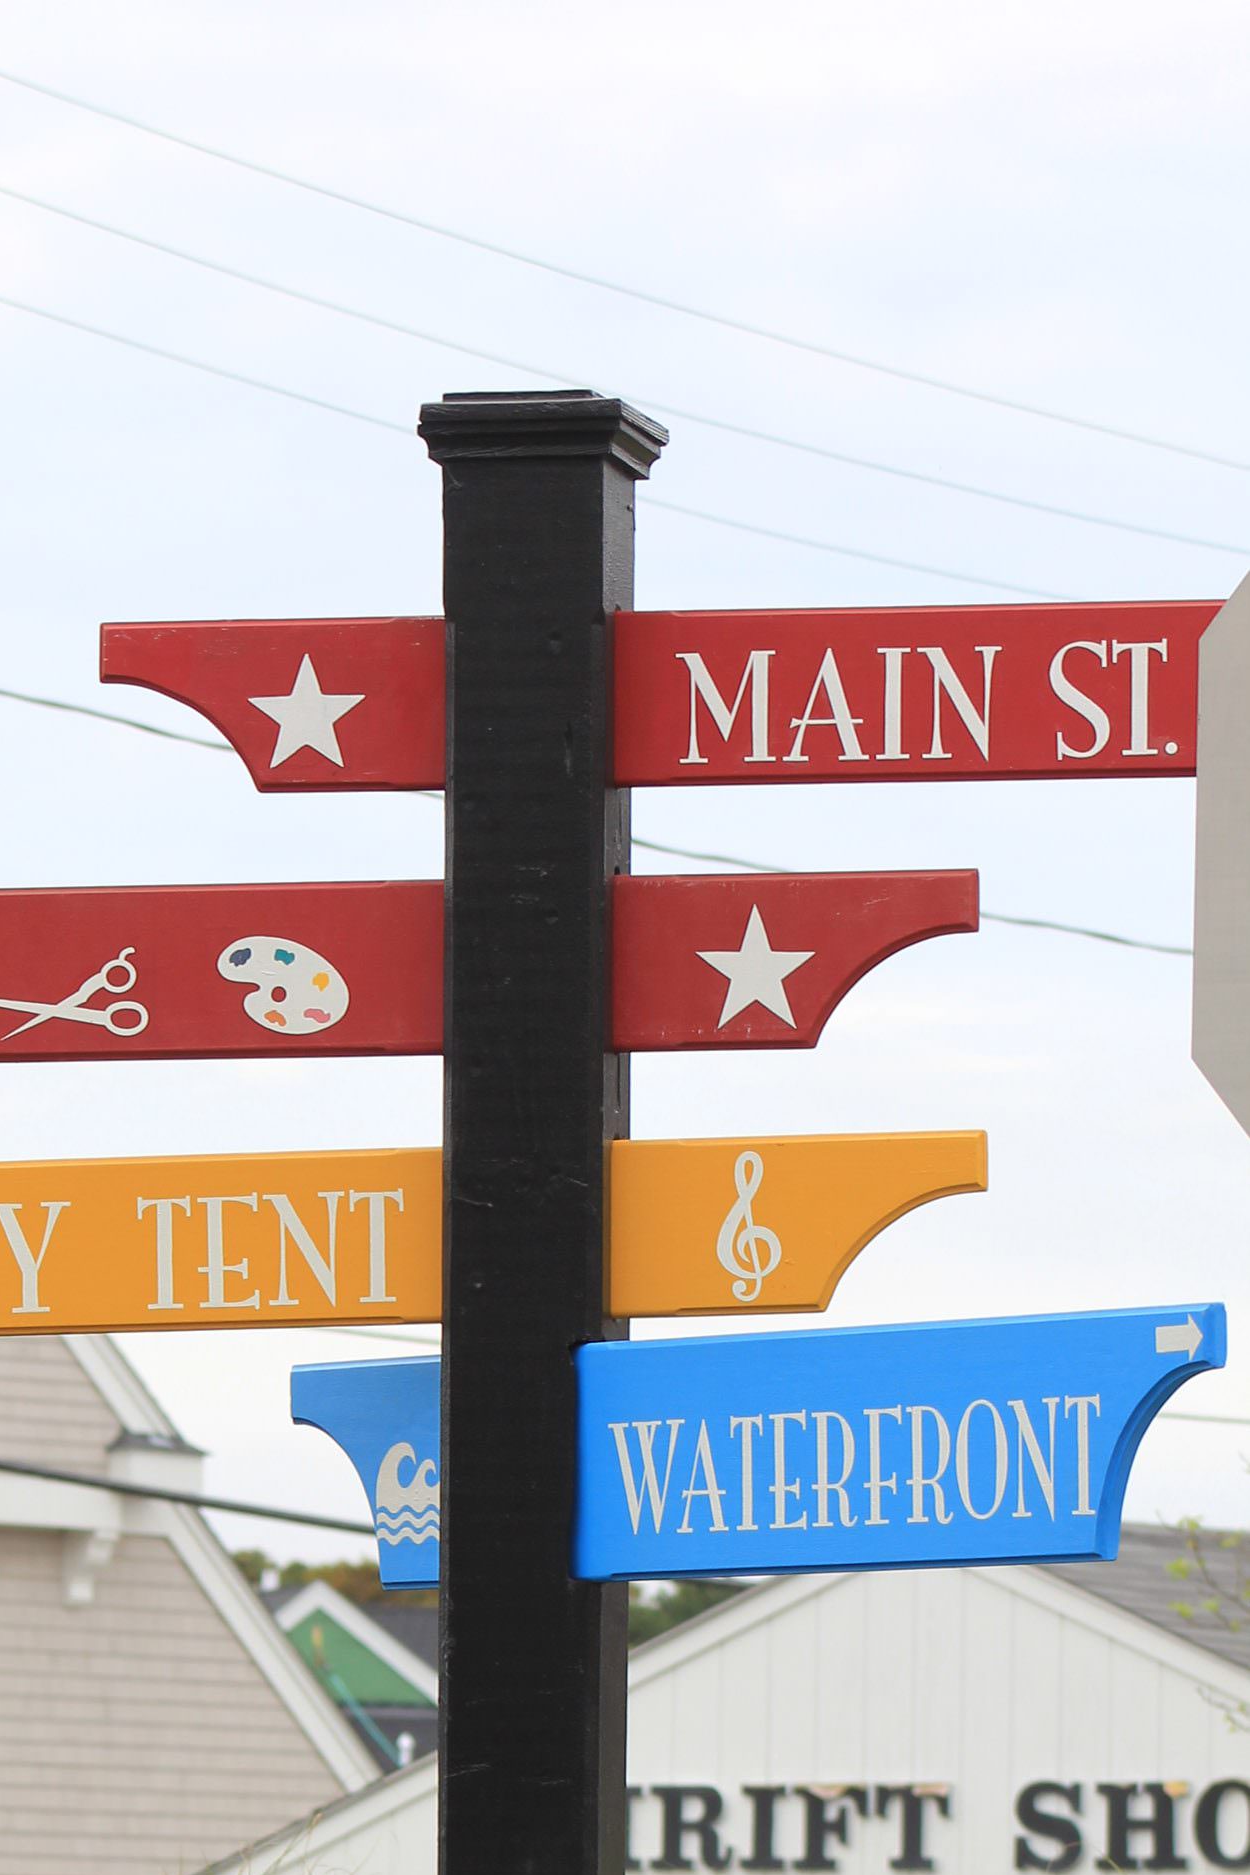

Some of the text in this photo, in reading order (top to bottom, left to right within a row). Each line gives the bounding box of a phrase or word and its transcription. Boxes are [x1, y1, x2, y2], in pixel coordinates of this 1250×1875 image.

[675, 637, 1178, 764] MAIN ST.
[136, 1188, 404, 1310] TENT
[607, 1393, 1101, 1535] WATERFRONT
[625, 1782, 951, 1873] RIFT
